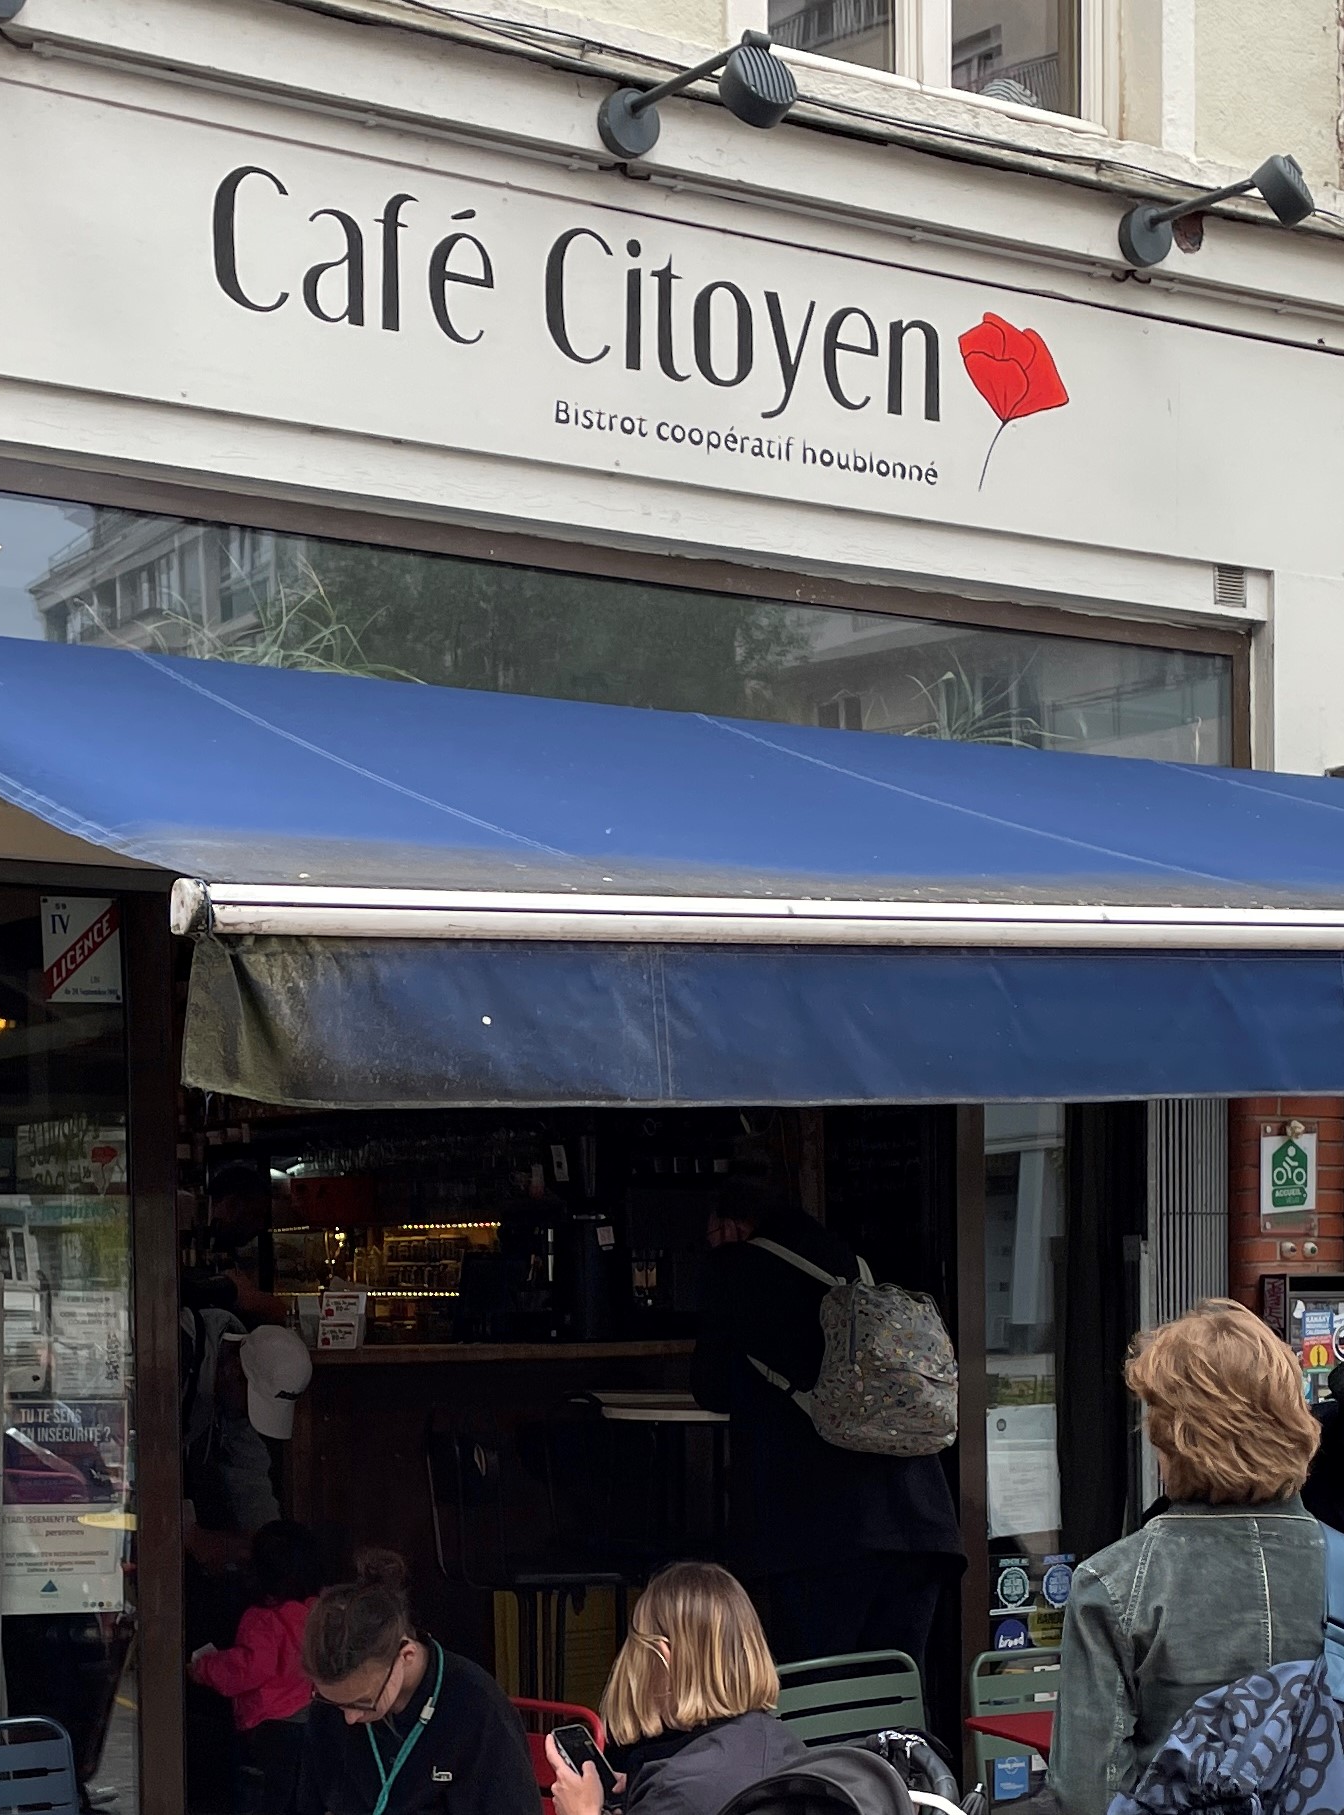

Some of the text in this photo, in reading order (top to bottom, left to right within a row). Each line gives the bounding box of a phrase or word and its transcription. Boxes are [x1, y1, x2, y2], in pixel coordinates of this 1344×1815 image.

[212, 166, 940, 421] Café Citoyen
[555, 400, 939, 487] Bistrot coopératif houblonné
[50, 914, 70, 935] IV
[52, 913, 111, 988] LICENCE
[20, 1408, 82, 1424] TU TE SENS
